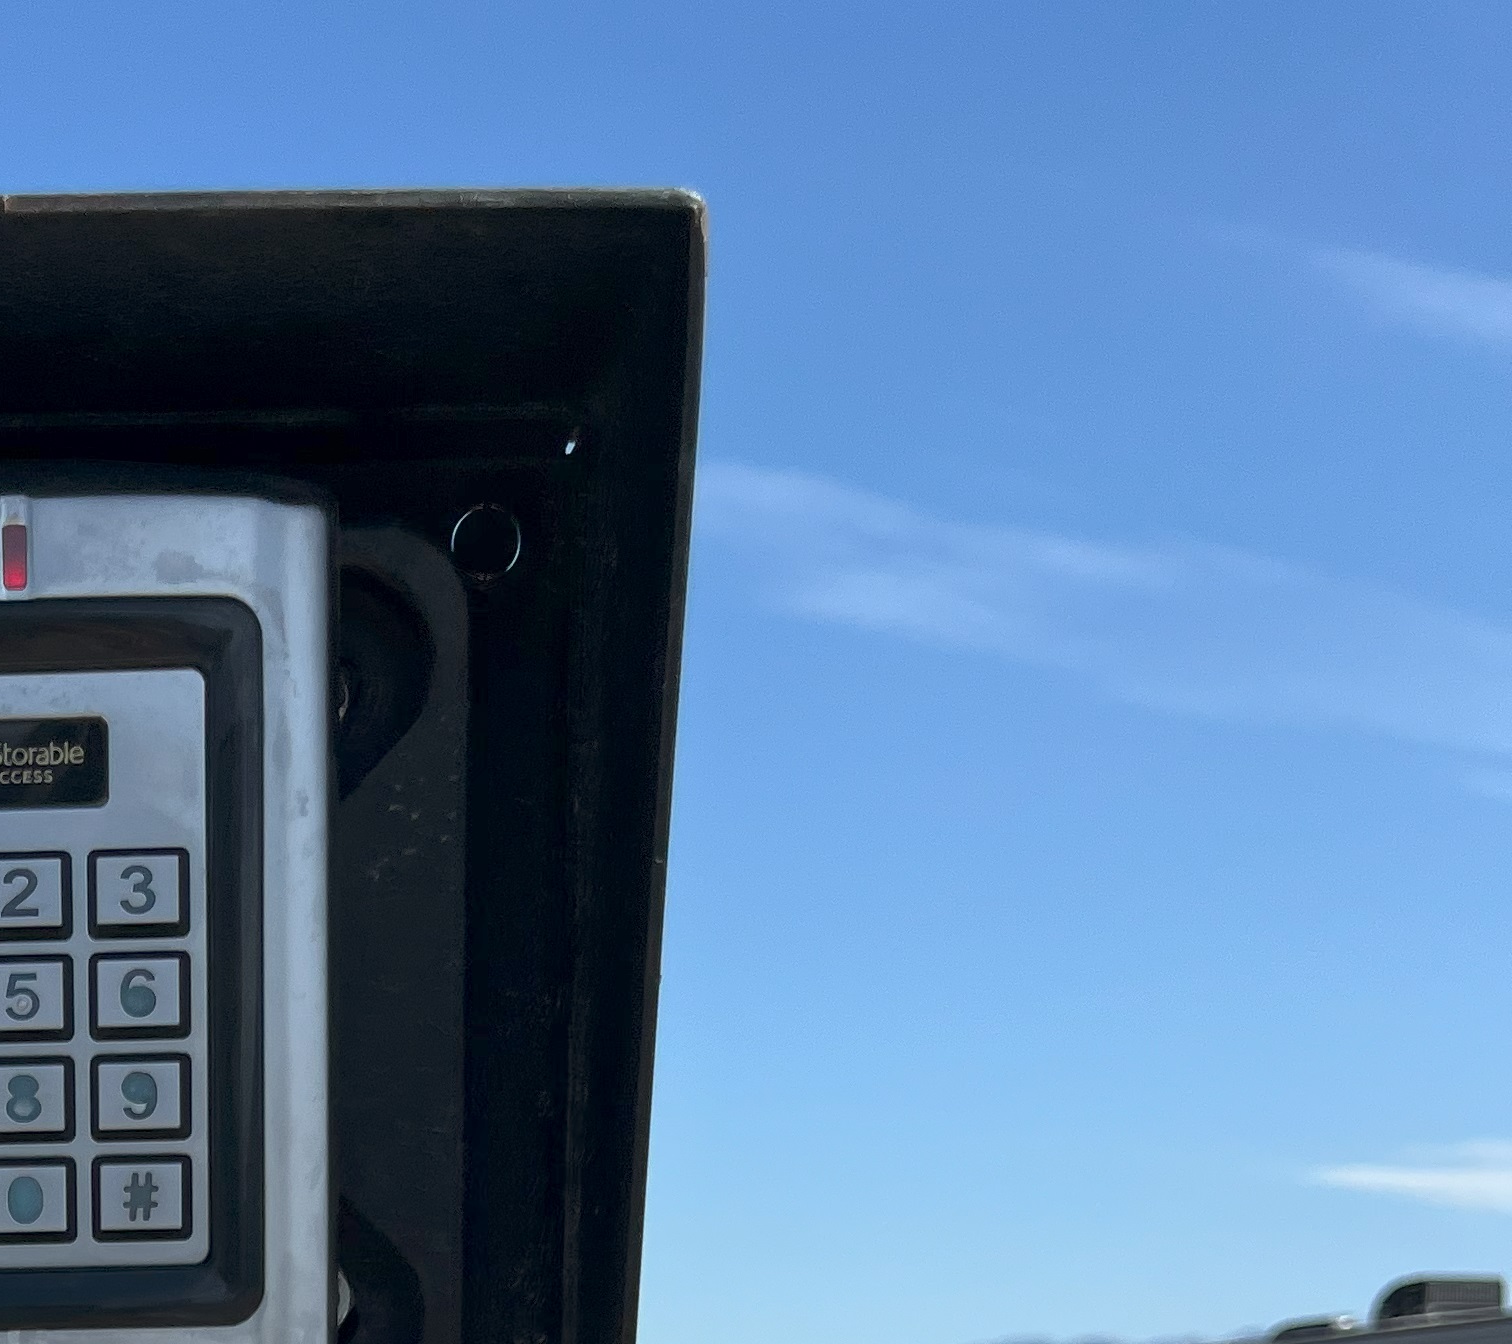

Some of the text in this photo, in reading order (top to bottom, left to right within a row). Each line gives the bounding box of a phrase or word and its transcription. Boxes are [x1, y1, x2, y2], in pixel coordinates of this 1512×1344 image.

[0, 868, 39, 918] 2
[119, 865, 157, 915] 3
[4, 972, 41, 1022] 5
[119, 969, 157, 1018] 6
[5, 1074, 42, 1123] 8
[120, 1071, 158, 1120] 9
[7, 1176, 44, 1225] 0
[122, 1172, 159, 1222] #
